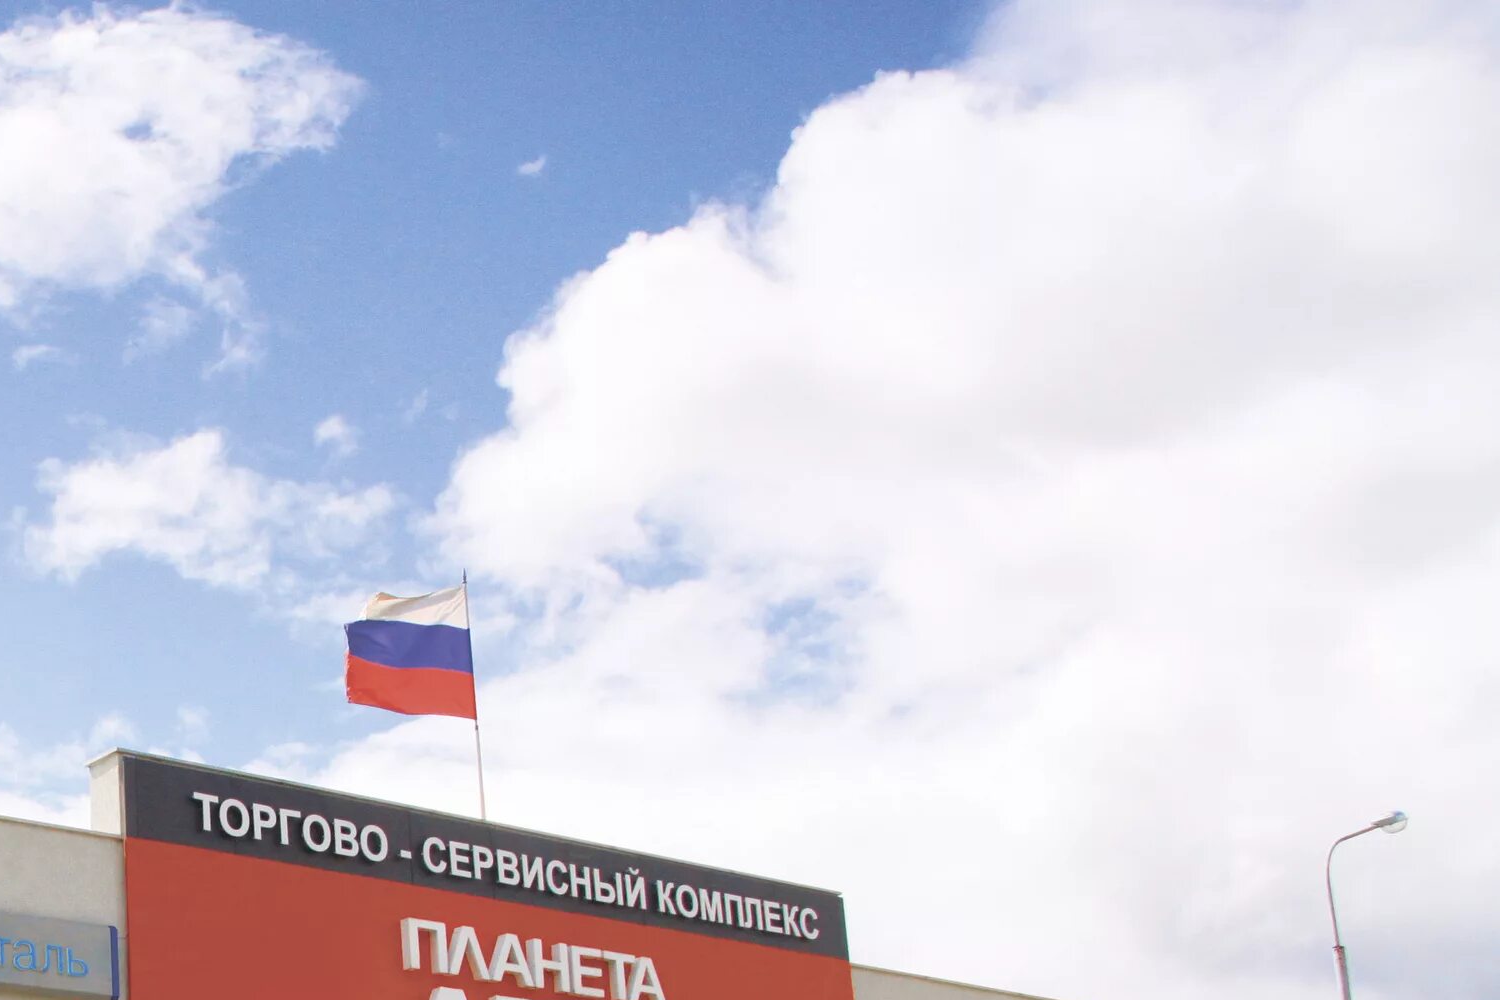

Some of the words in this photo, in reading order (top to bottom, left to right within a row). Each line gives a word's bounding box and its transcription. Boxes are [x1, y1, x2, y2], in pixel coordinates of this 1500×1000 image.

[193, 792, 388, 863] ТОРГОВО
[423, 837, 647, 910] СЕРВИСНЫЙ
[657, 879, 819, 941] КОМПЛЕКС
